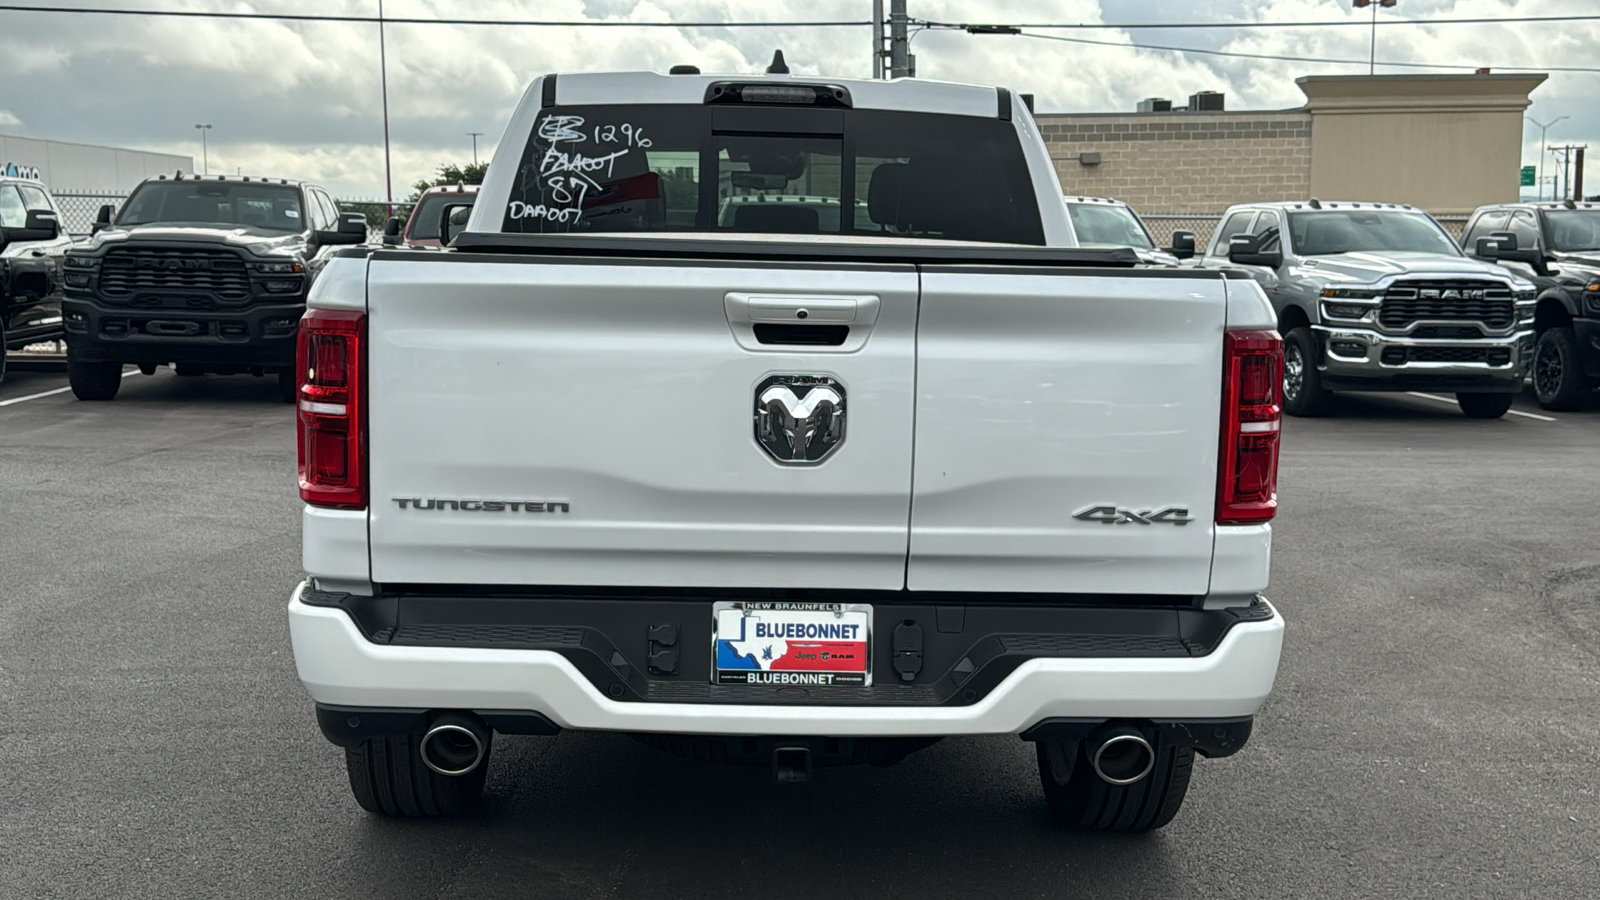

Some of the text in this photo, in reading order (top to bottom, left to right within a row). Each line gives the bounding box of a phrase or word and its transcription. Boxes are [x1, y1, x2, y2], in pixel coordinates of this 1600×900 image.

[594, 123, 652, 148] 1296
[142, 259, 207, 269] RAM
[1420, 289, 1483, 299] RAM
[773, 376, 829, 385] RAM
[392, 497, 569, 513] TUNGSTEN
[756, 623, 859, 639] BLUEBONNET
[795, 652, 817, 661] Jeep
[747, 673, 834, 684] BLUEBONNET
